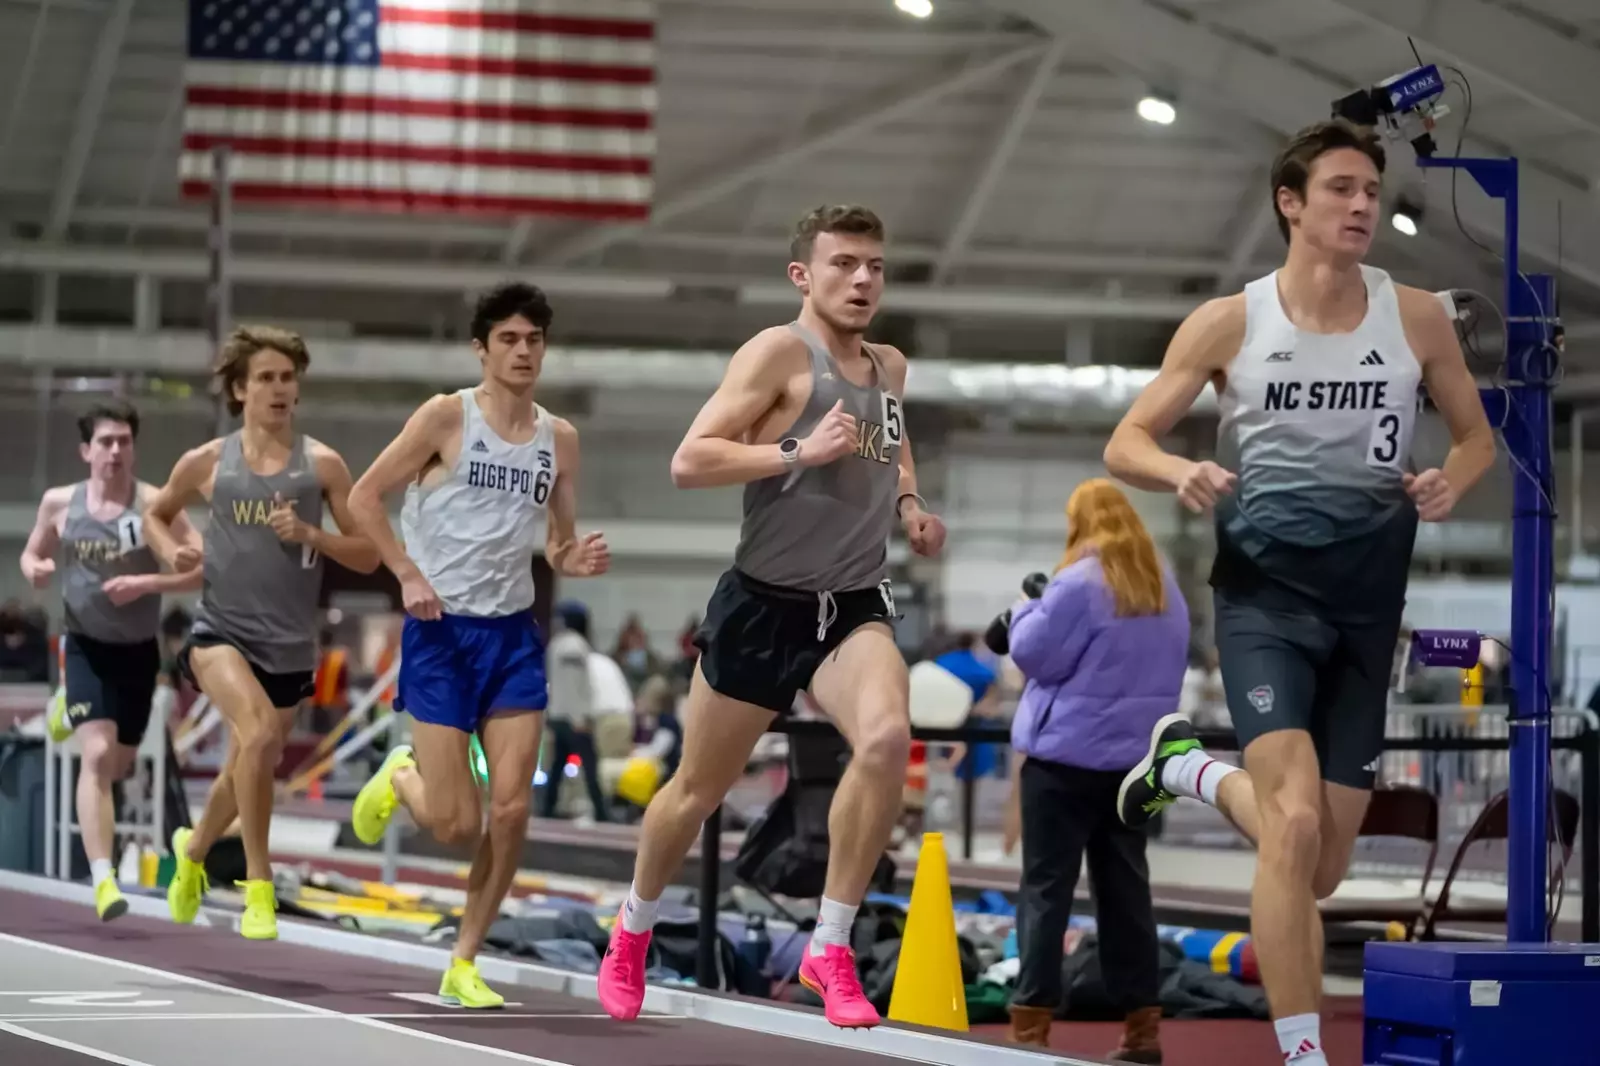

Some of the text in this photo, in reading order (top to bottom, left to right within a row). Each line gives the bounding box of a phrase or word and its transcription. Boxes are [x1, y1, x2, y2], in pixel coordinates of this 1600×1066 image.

[1404, 75, 1434, 95] LYNX
[1265, 352, 1294, 362] ACC
[1265, 381, 1388, 411] NC STATE
[886, 397, 901, 441] 5
[1373, 414, 1400, 463] 3
[468, 461, 507, 491] HIGH
[534, 470, 551, 505] 6
[123, 520, 137, 547] 1
[1433, 636, 1470, 649] LYNX
